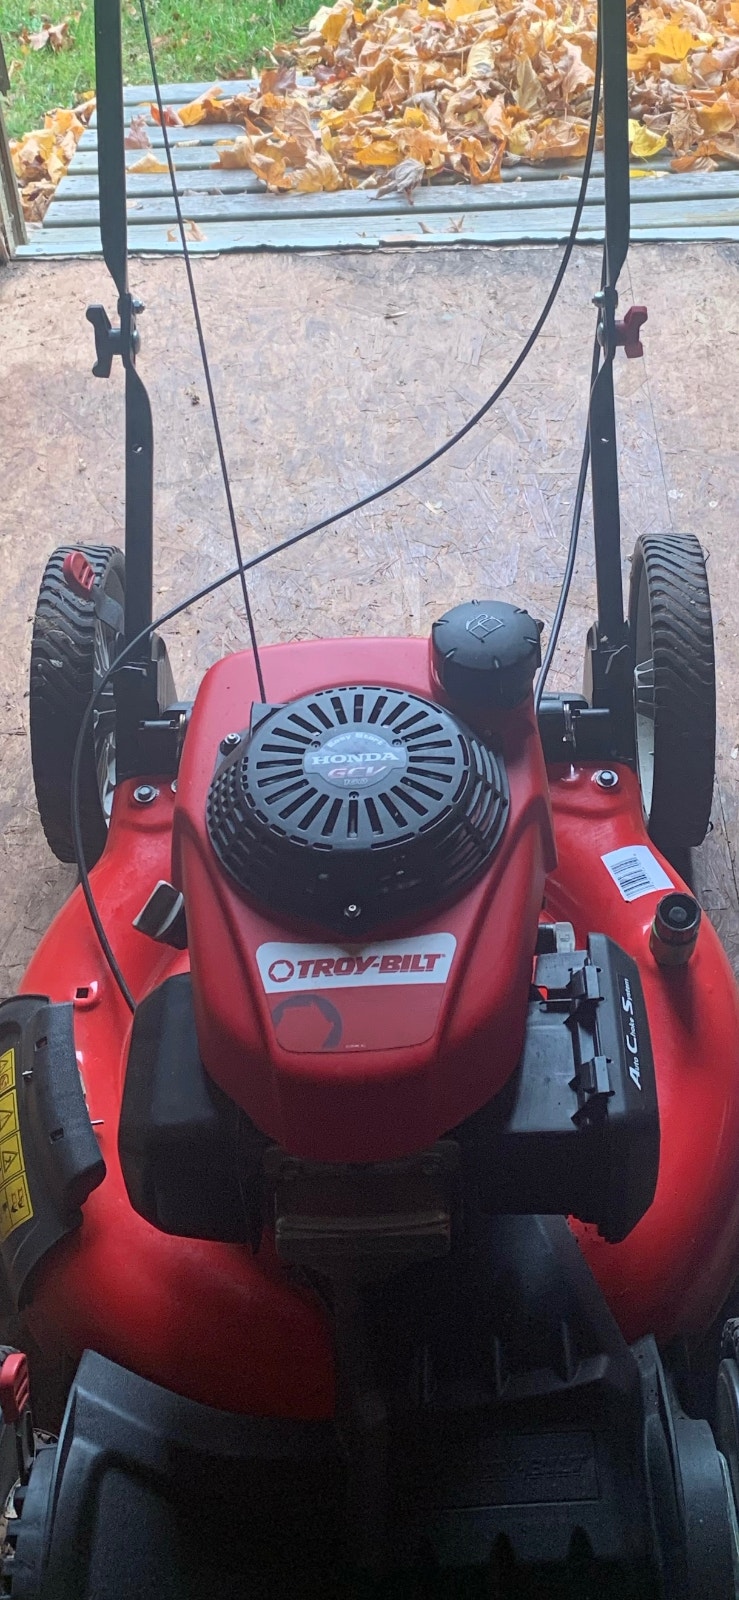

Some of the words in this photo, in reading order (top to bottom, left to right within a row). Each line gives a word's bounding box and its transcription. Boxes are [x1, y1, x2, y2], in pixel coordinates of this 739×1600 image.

[312, 752, 399, 766] HONDA
[327, 766, 388, 779] GCV
[297, 953, 442, 979] TROY-BILT
[621, 977, 634, 1015] System
[626, 1017, 638, 1054] Choke
[629, 1056, 642, 1091] Auto
